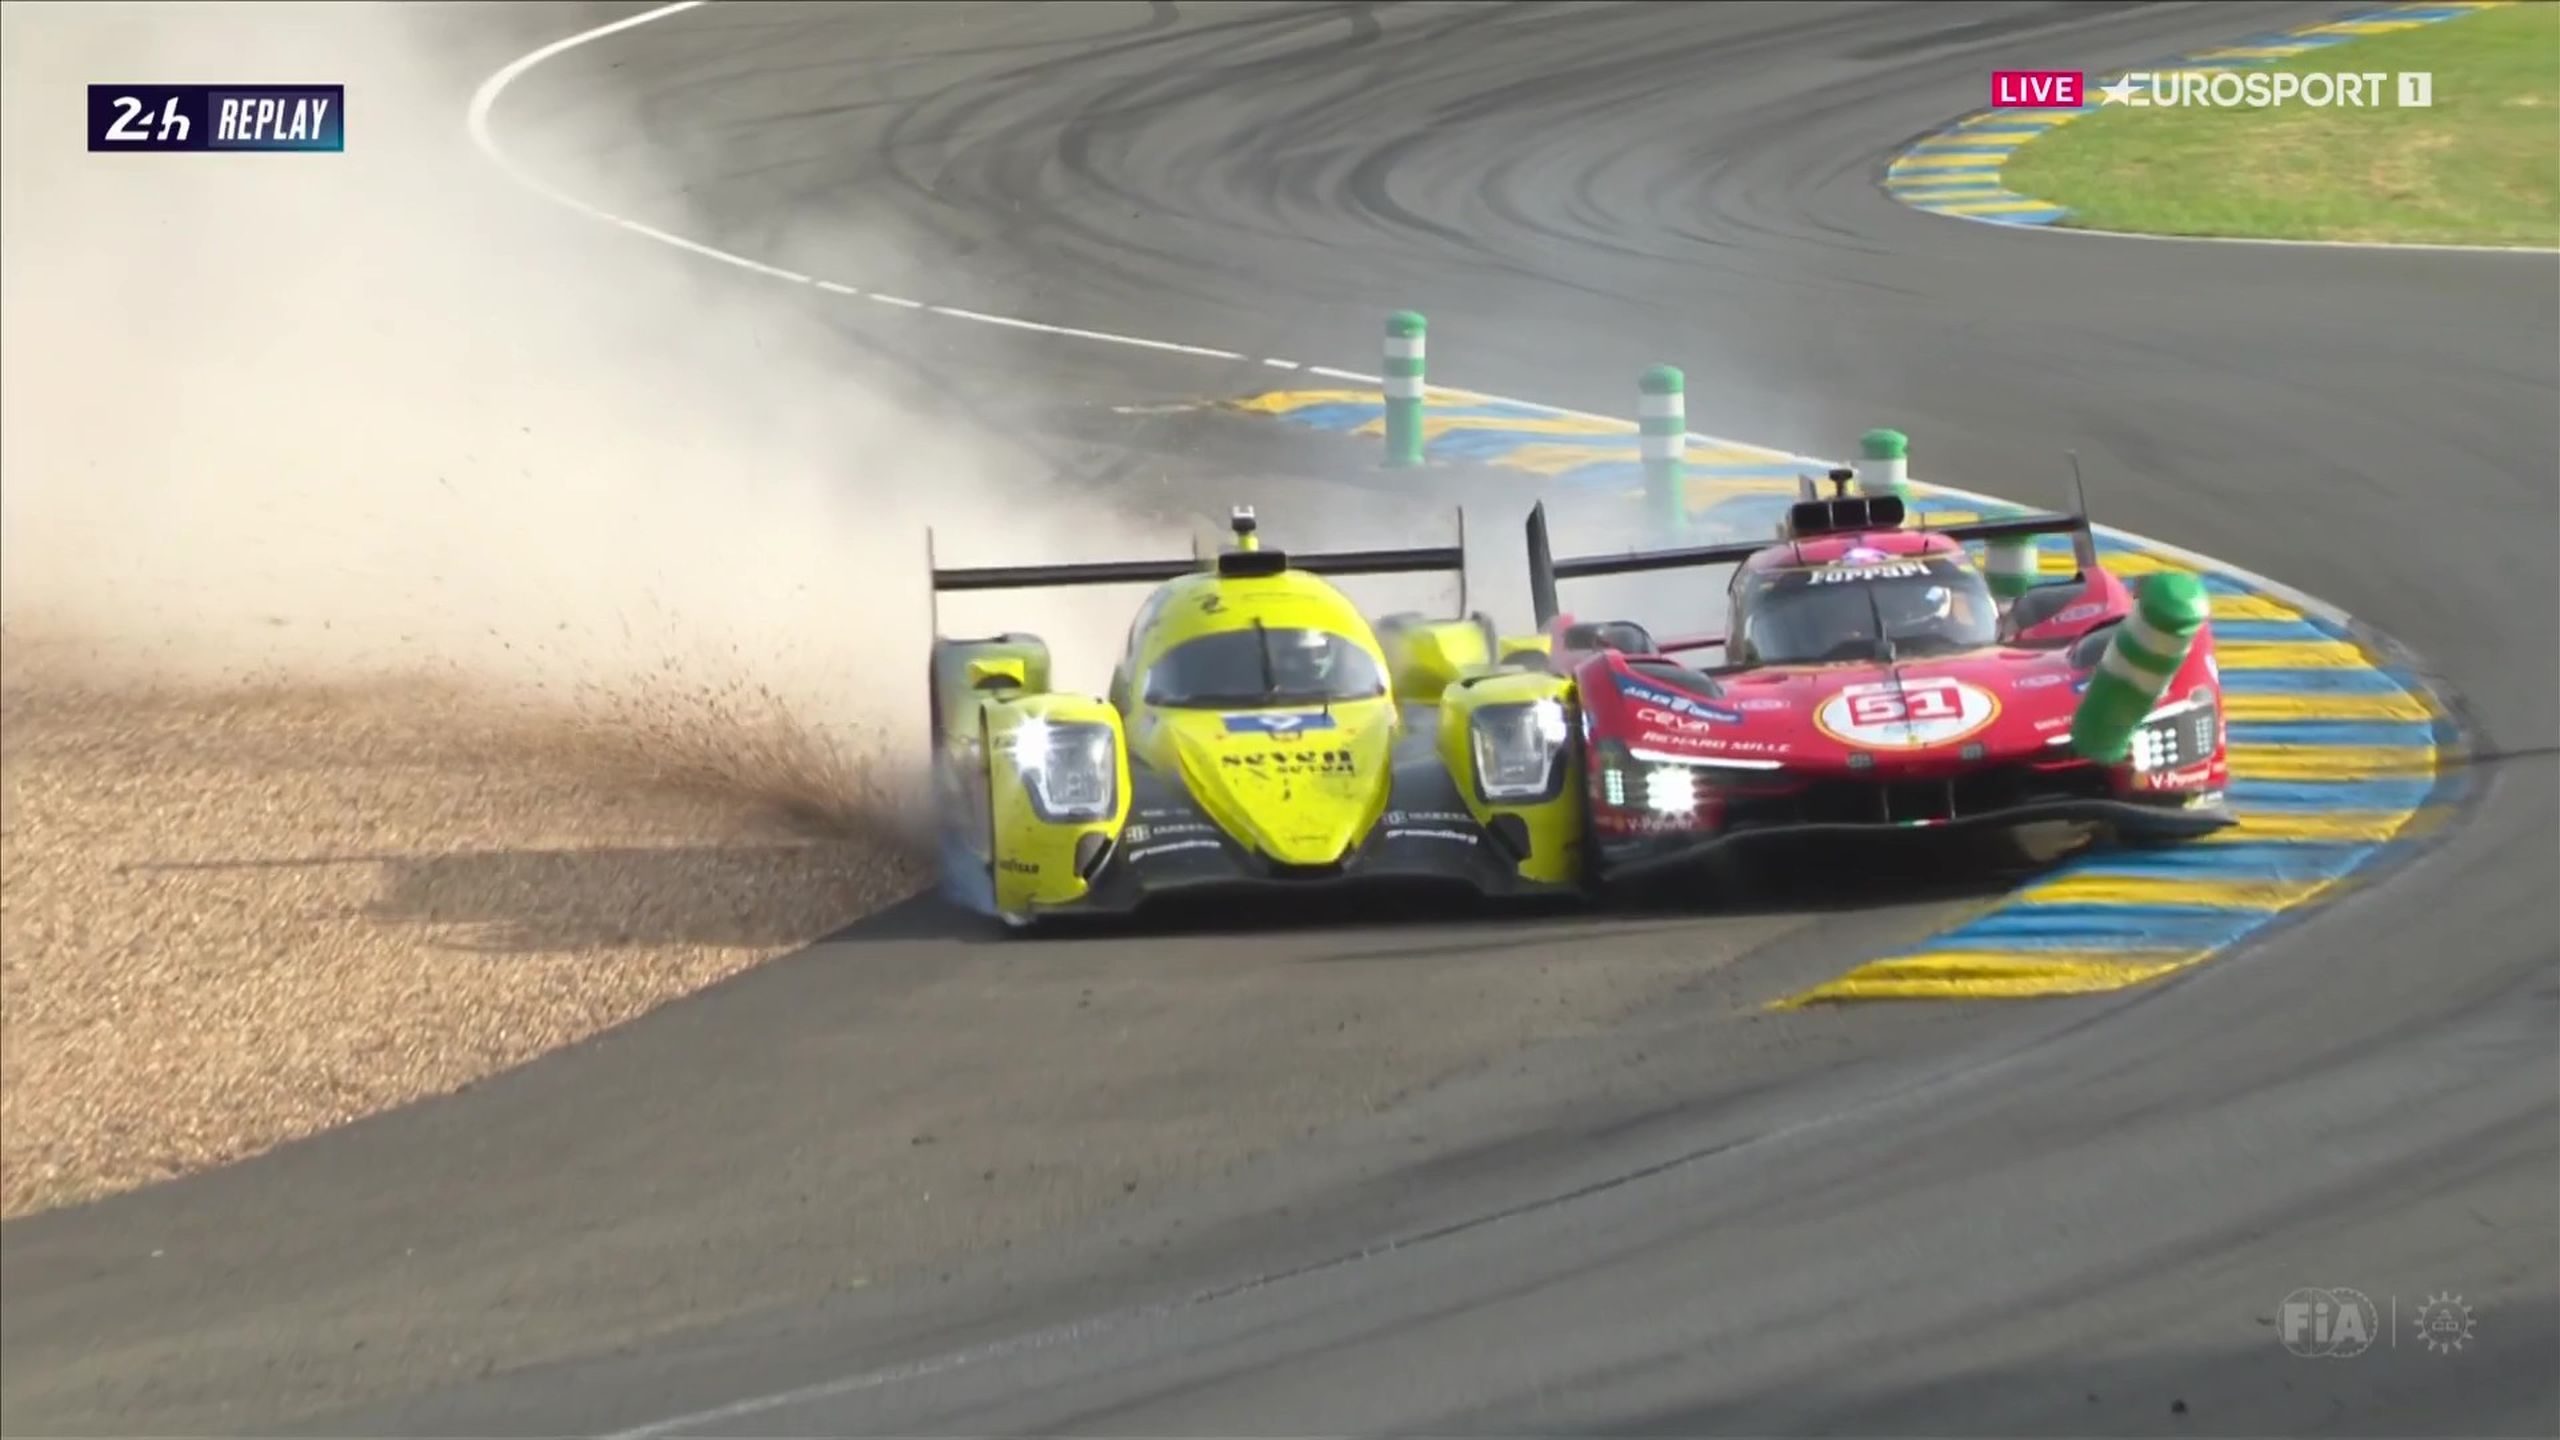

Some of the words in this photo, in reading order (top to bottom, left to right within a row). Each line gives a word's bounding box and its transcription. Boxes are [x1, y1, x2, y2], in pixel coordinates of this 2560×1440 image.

[1806, 560, 1932, 585] Ferrari
[1856, 689, 1957, 721] 51
[1641, 730, 1727, 749] RICHARD
[1730, 740, 1791, 752] MILLE
[2151, 768, 2211, 789] V-Power
